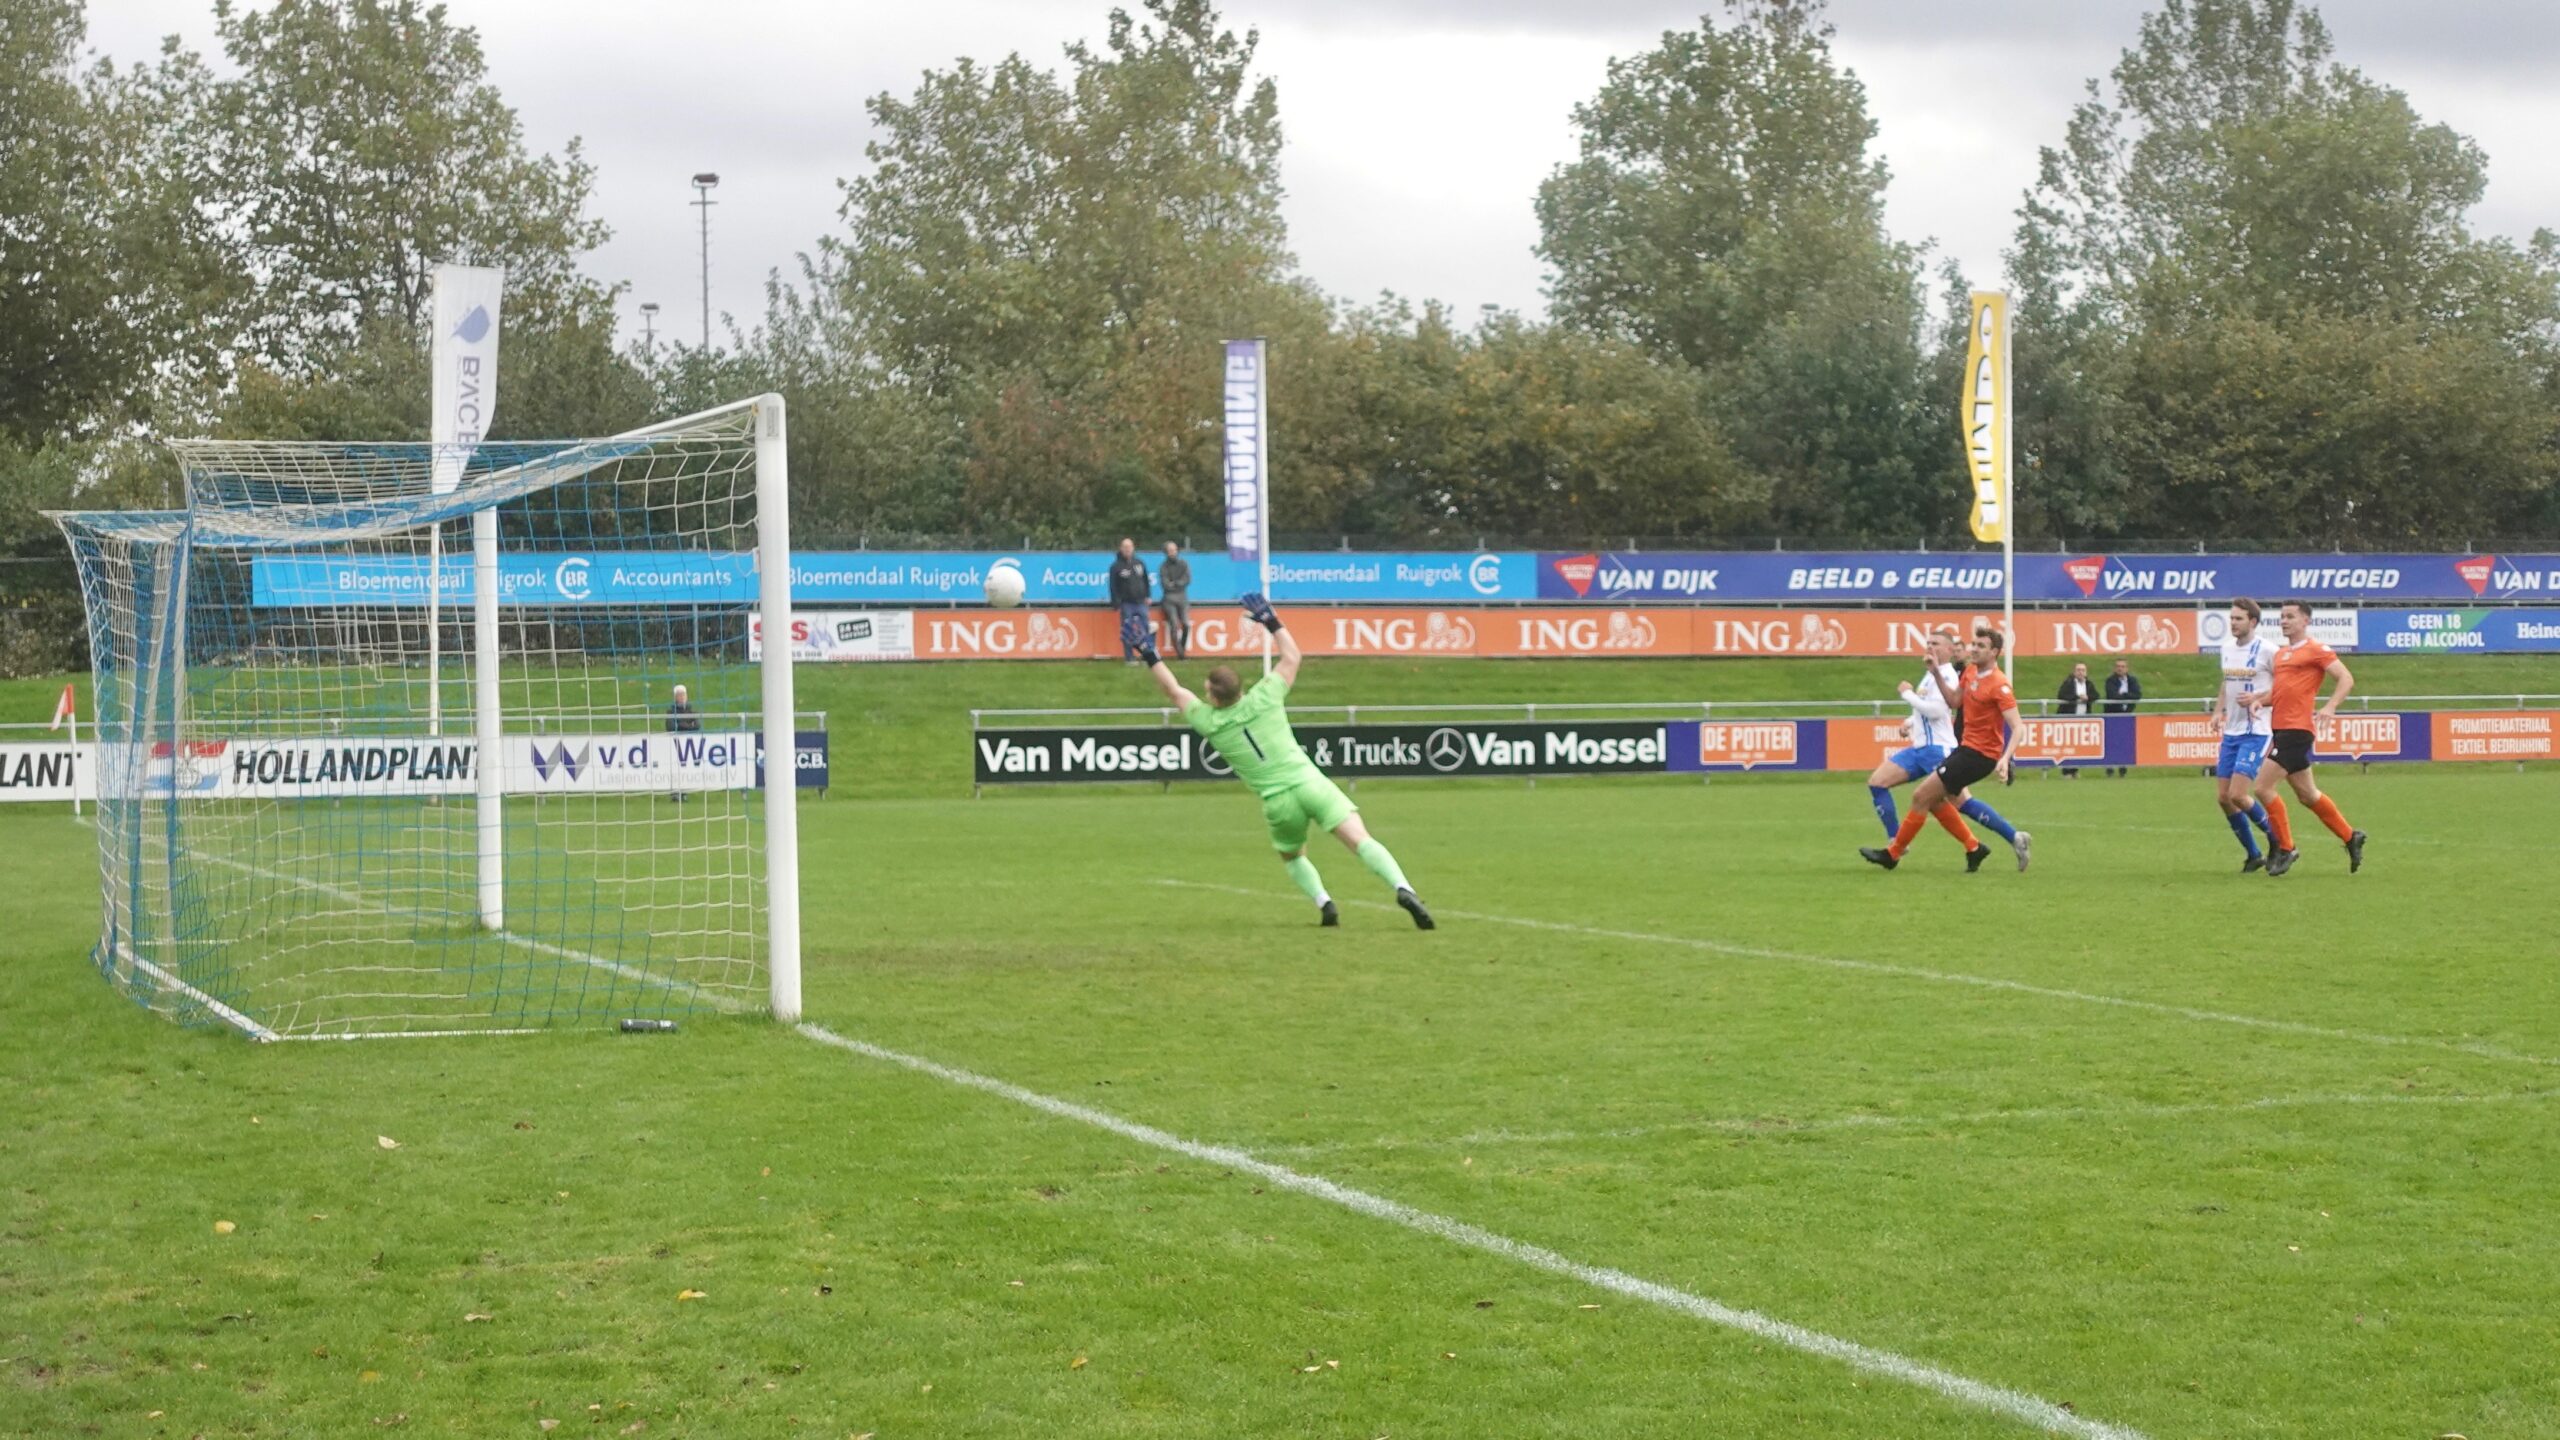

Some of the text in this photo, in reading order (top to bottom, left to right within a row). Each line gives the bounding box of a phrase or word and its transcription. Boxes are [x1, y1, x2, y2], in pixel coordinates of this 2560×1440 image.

[499, 567, 546, 594] igrok
[612, 568, 732, 586] Accountants
[788, 566, 902, 586] Bloemendaal
[910, 566, 980, 591] Ruigrok
[1269, 563, 1380, 583] Bloemendaal
[1397, 563, 1462, 587] Ruigrok
[1600, 568, 2004, 595] VAN DIJK BEELD & GELUID
[2104, 568, 2400, 594] VAN DIJK WITGOED
[2494, 570, 2560, 590] VAN D
[2311, 616, 2352, 626] REHOUSE
[2408, 614, 2462, 629] GEEN 18
[929, 620, 1017, 653] ING
[1155, 619, 1229, 653] NG
[1333, 618, 1416, 651] ING
[1518, 619, 1600, 650] ING
[1713, 620, 1792, 652] ING
[2053, 621, 2127, 653] ING
[2386, 632, 2485, 648] GEEN ALCOHOL
[1704, 725, 1792, 751] DE POTTER
[2018, 722, 2100, 747] DE POTTER
[2163, 721, 2217, 738] AUTOBELE
[2341, 719, 2396, 742] POTTER
[599, 737, 736, 768] v.d. Wel
[979, 728, 1666, 773] Van Mossel & Trucks Van Mossel
[1243, 728, 1265, 761] 1
[2167, 742, 2219, 759] BUITENRE
[2452, 738, 2488, 754] TEXTIEL
